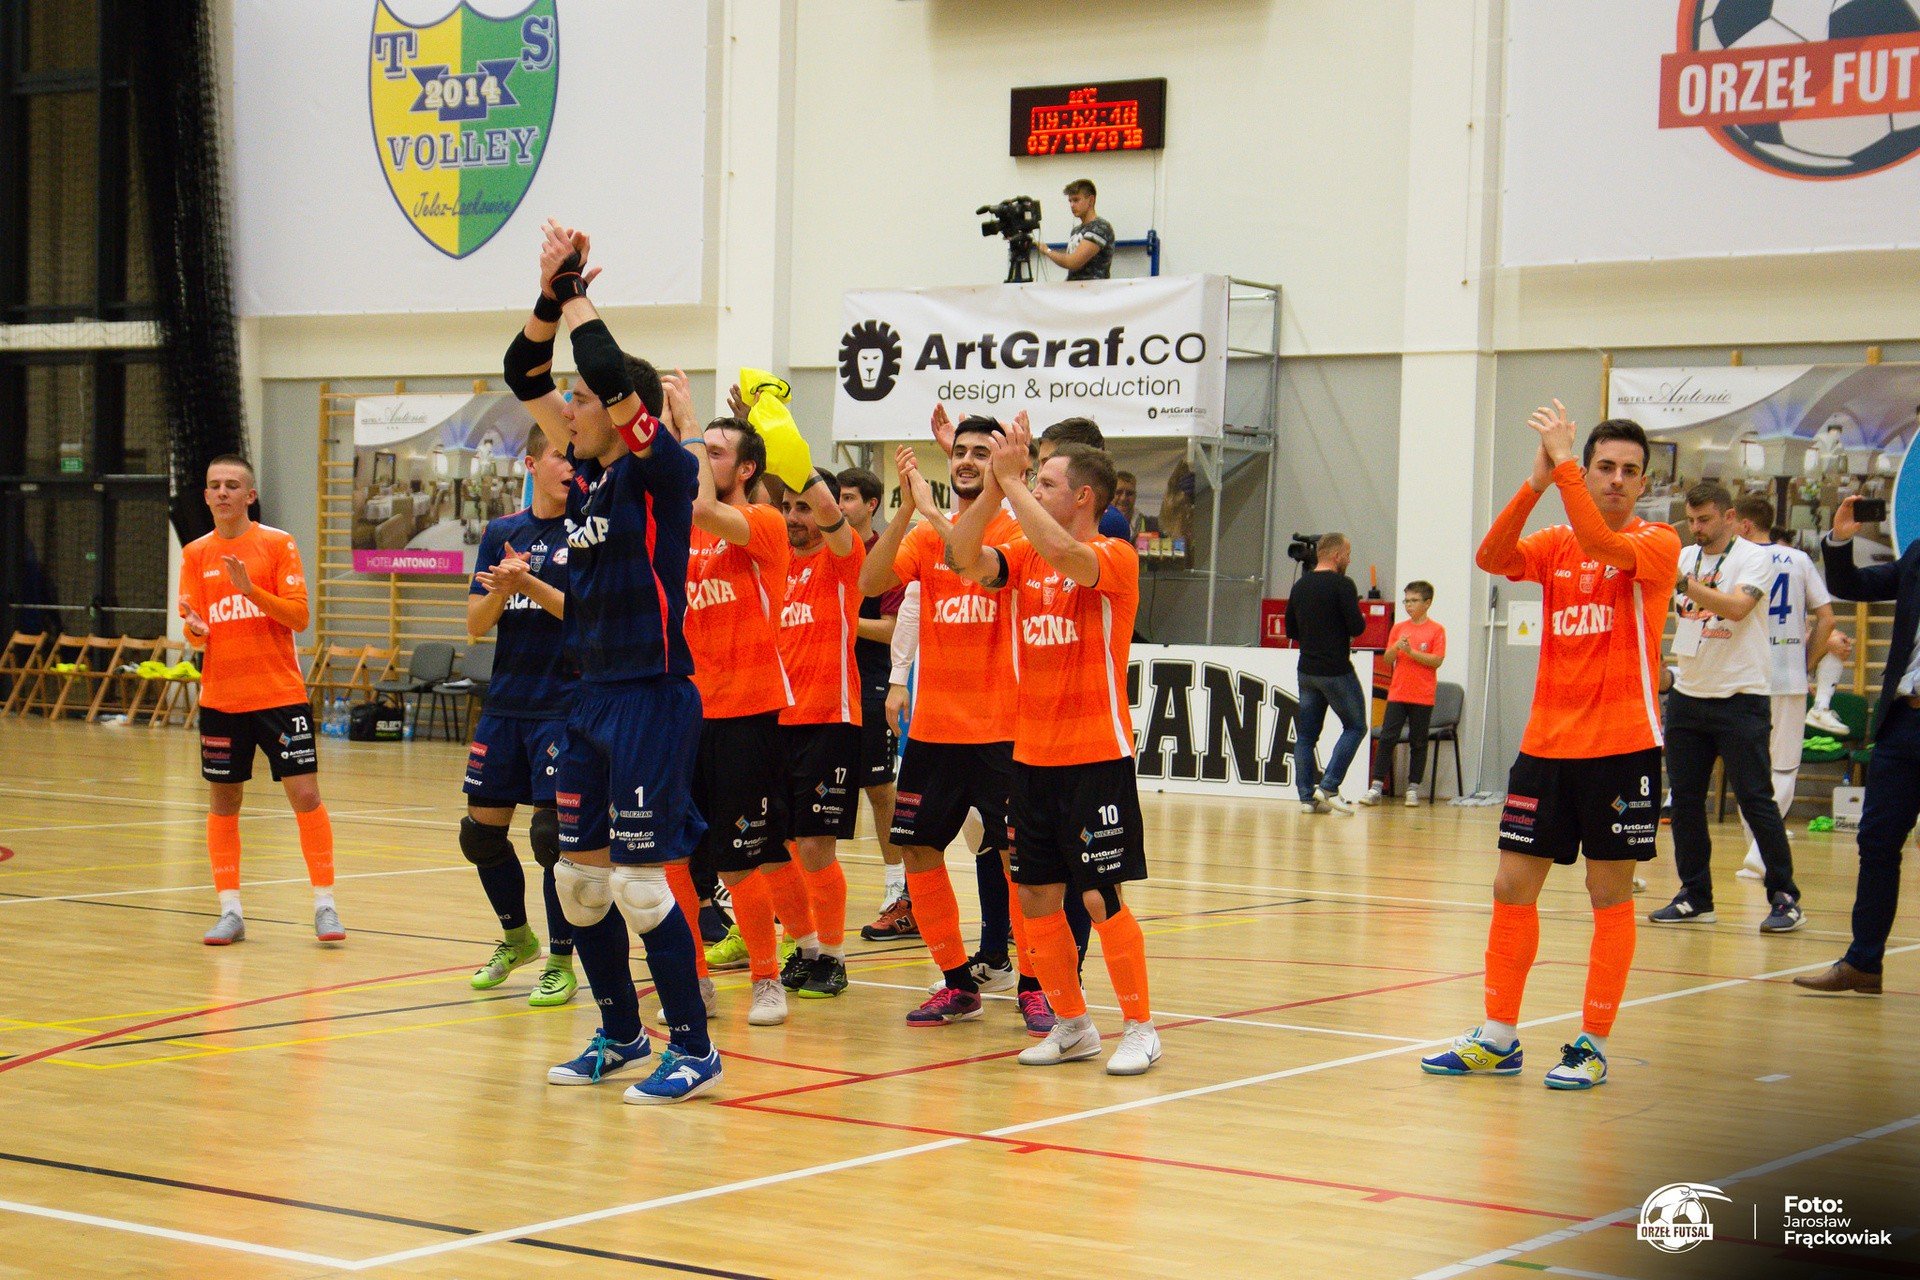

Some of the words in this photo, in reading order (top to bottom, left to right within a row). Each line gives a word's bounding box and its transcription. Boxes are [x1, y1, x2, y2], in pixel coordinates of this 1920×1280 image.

[374, 31, 418, 80] T
[521, 14, 555, 71] S
[424, 75, 501, 108] 2014
[1678, 56, 1816, 118] ORZEŁ
[387, 126, 539, 171] VOLLEY
[914, 325, 1207, 371] ArtGraf.co
[937, 380, 1016, 404] design
[1024, 378, 1041, 400] &
[1049, 376, 1181, 403] production
[632, 412, 655, 444] C
[1768, 572, 1793, 625] 4
[291, 715, 308, 732] 73
[834, 767, 847, 784] 17
[1640, 775, 1650, 797] 8
[634, 785, 644, 807] 1
[761, 797, 768, 816] 9
[1098, 804, 1119, 826] 10
[636, 841, 655, 850] JAKO
[1636, 836, 1654, 844] JAKO
[1106, 861, 1121, 871] JAKO
[1587, 999, 1612, 1010] JAKO
